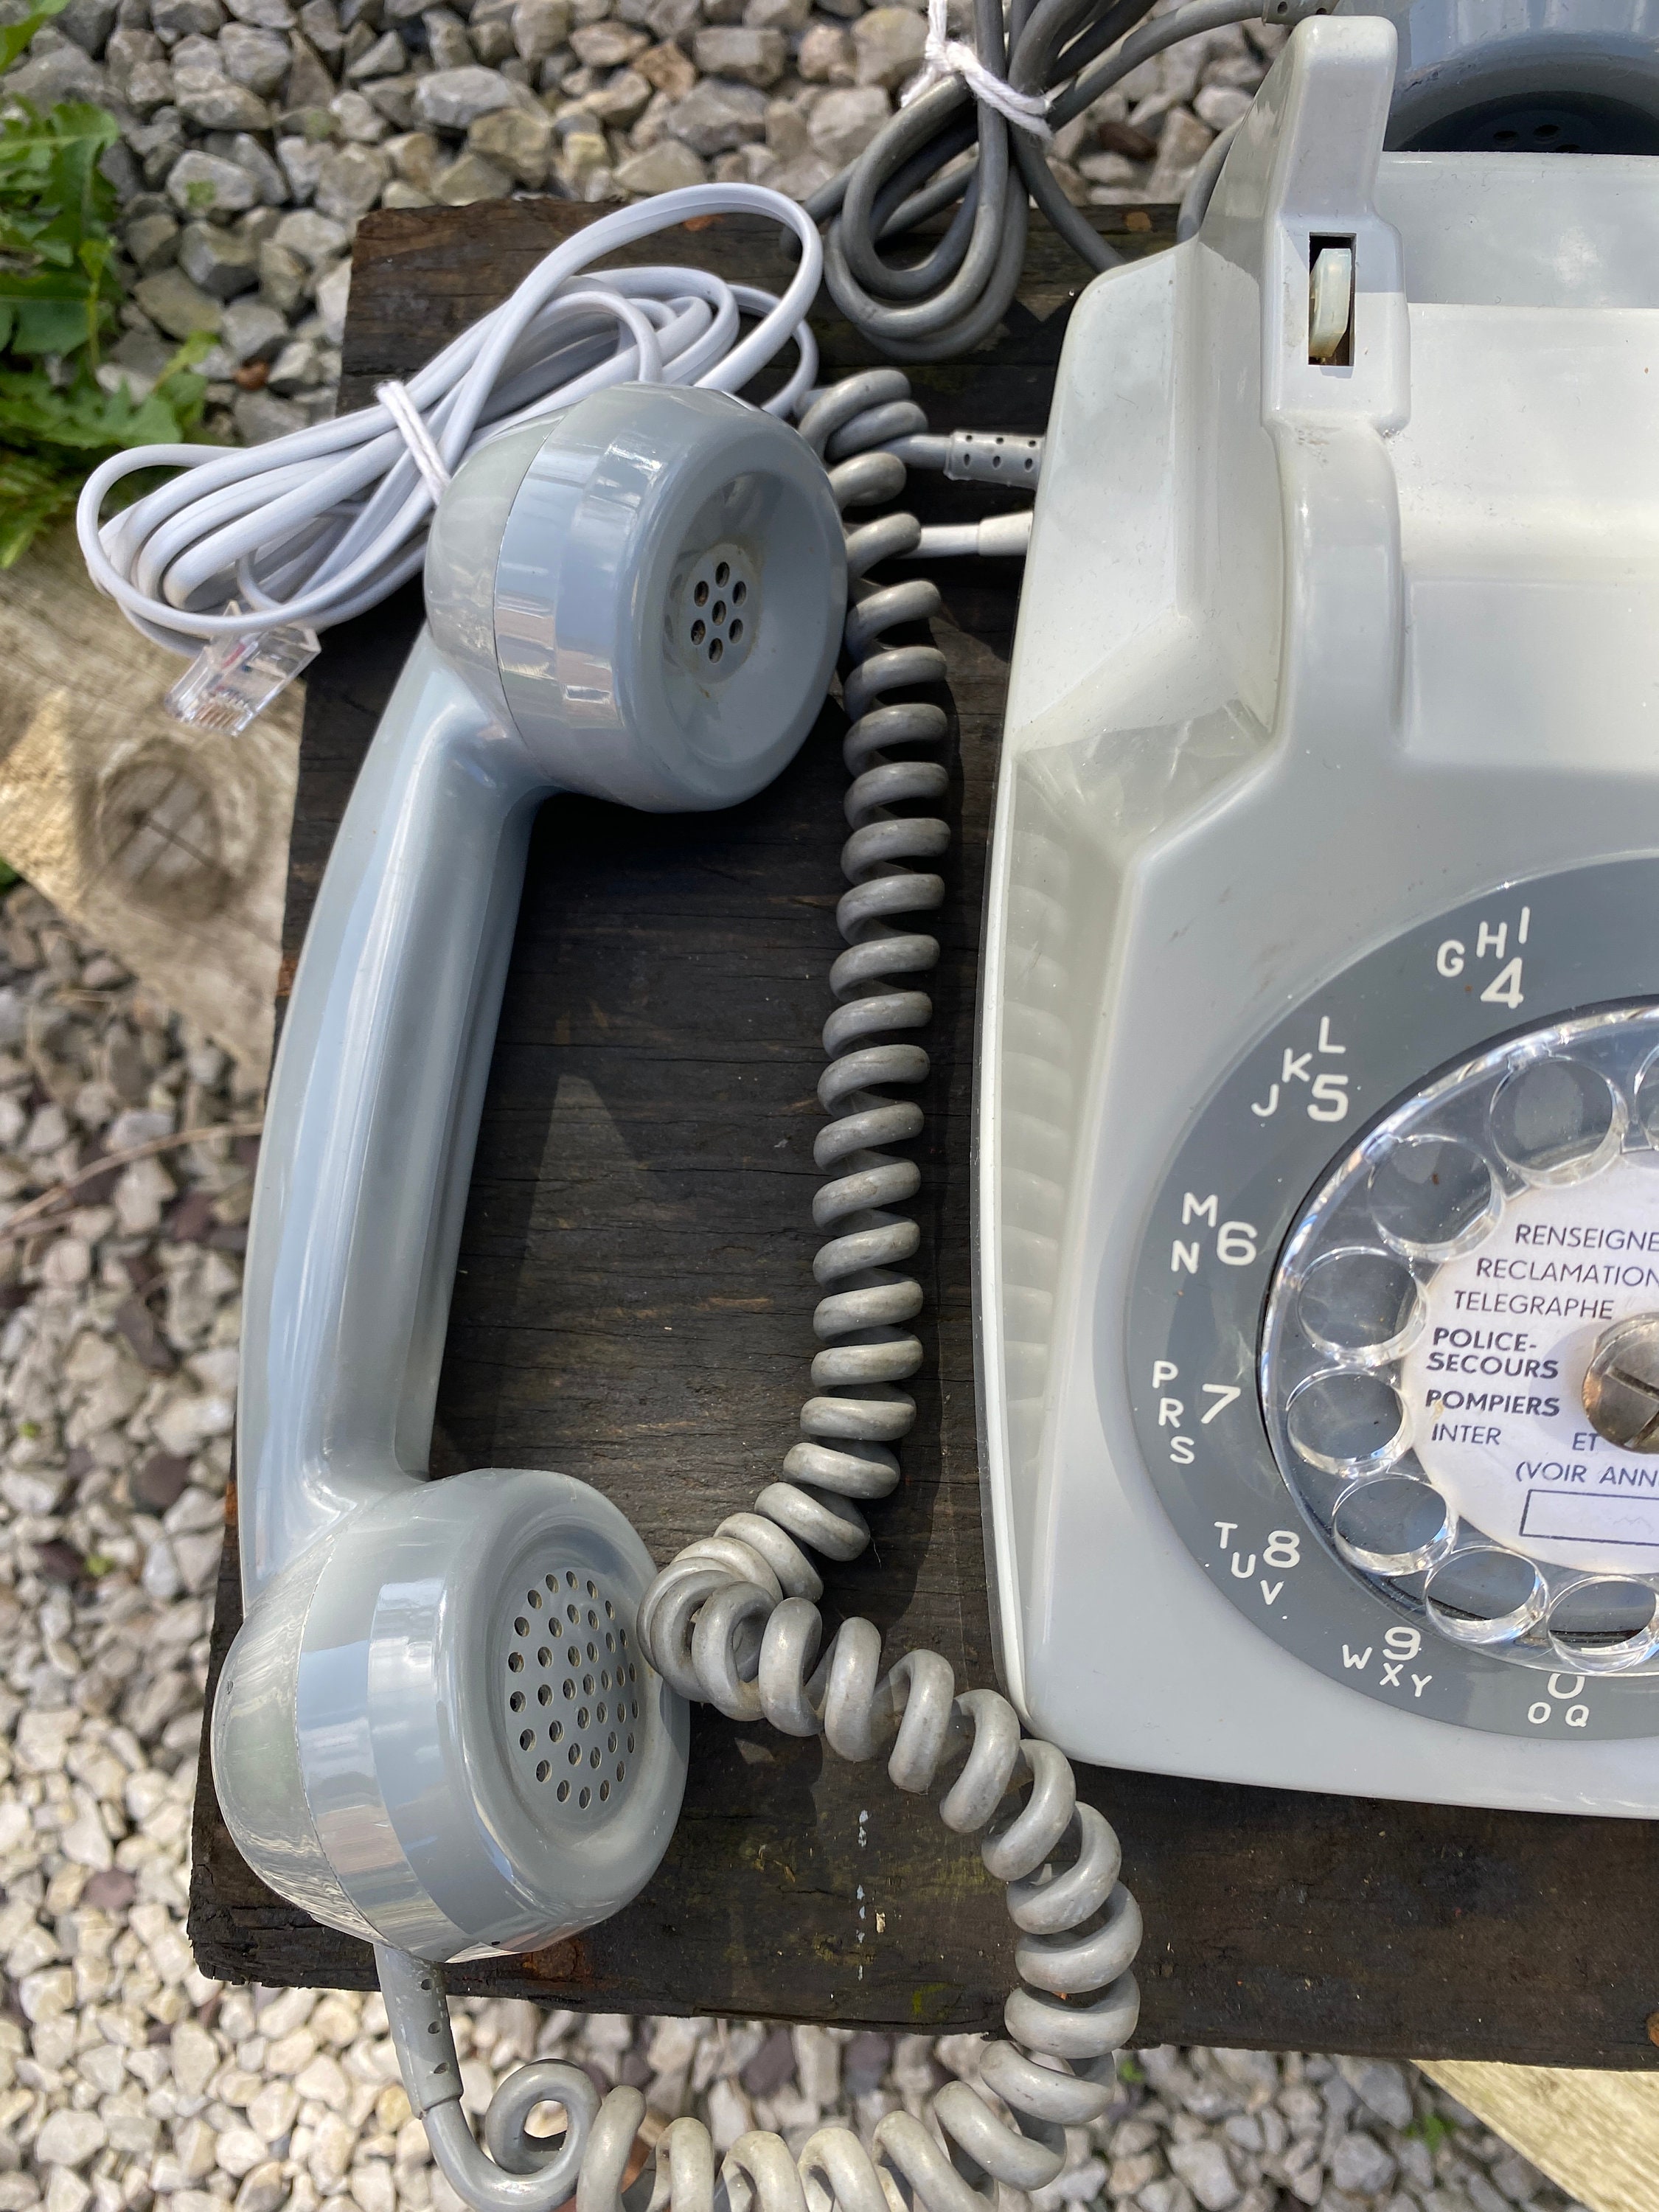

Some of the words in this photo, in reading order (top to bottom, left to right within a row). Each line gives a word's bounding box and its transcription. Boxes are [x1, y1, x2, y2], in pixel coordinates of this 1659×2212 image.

[1480, 956, 1524, 1009] 4
[1307, 1074, 1349, 1121] 5
[1216, 1221, 1257, 1265] 6
[1514, 1223, 1659, 1252] RENSEIGNE
[1454, 1290, 1615, 1320] TELEGRAPHE
[1433, 1326, 1537, 1352] POLICE-
[1425, 1352, 1559, 1379] SECOURS
[1200, 1383, 1241, 1424] 7
[1425, 1389, 1560, 1417] POMPIERS
[1431, 1423, 1501, 1446] INTER
[1571, 1432, 1599, 1452] ET
[1515, 1461, 1587, 1483] (VOIR
[1262, 1530, 1300, 1568] 8
[1382, 1627, 1421, 1660] 9
